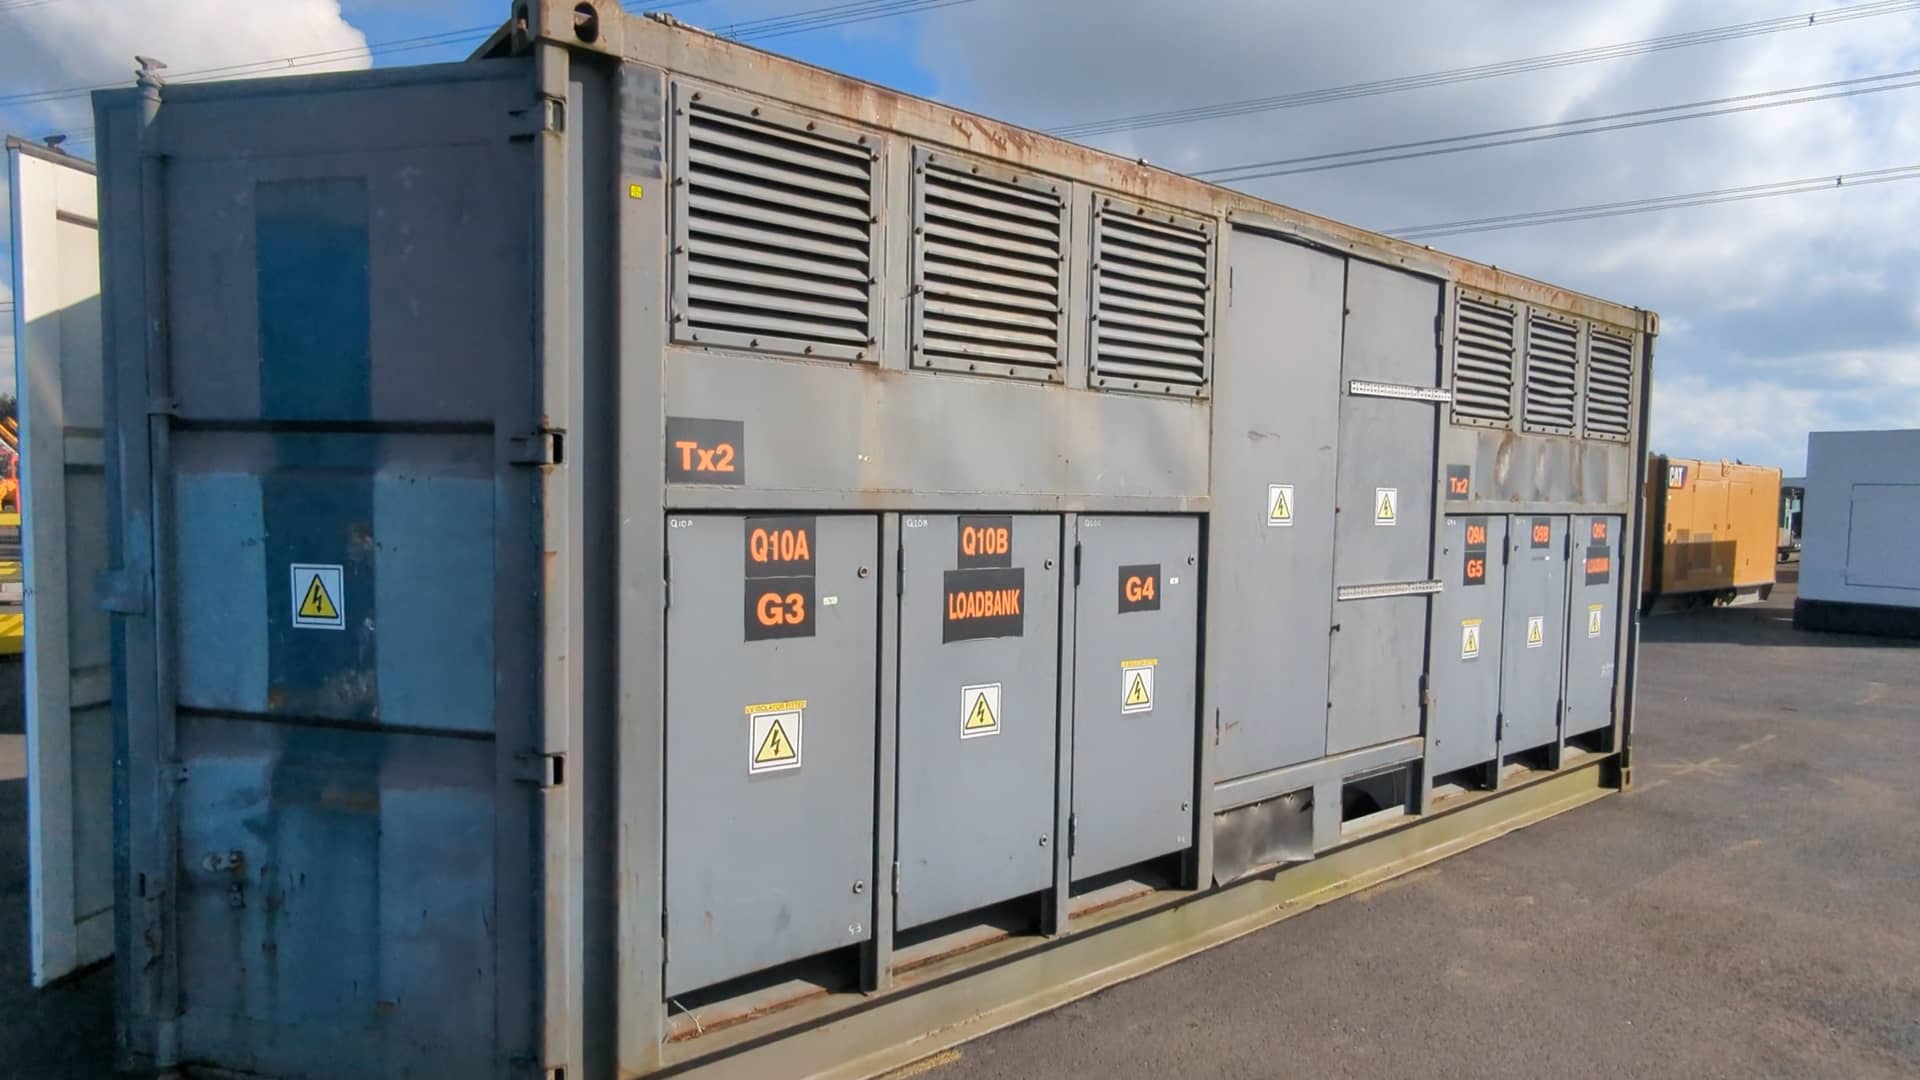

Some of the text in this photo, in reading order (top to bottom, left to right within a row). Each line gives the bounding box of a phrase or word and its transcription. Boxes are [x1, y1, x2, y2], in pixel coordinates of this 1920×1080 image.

[675, 440, 735, 472] Tx2
[1450, 477, 1468, 494] Tx2
[1669, 466, 1684, 488] CAT
[750, 528, 810, 563] Q10A
[962, 526, 1009, 556] Q10B
[1467, 559, 1484, 578] G5
[1125, 576, 1155, 602] G4
[756, 592, 805, 626] G3
[948, 589, 1020, 620] LOADBANK
